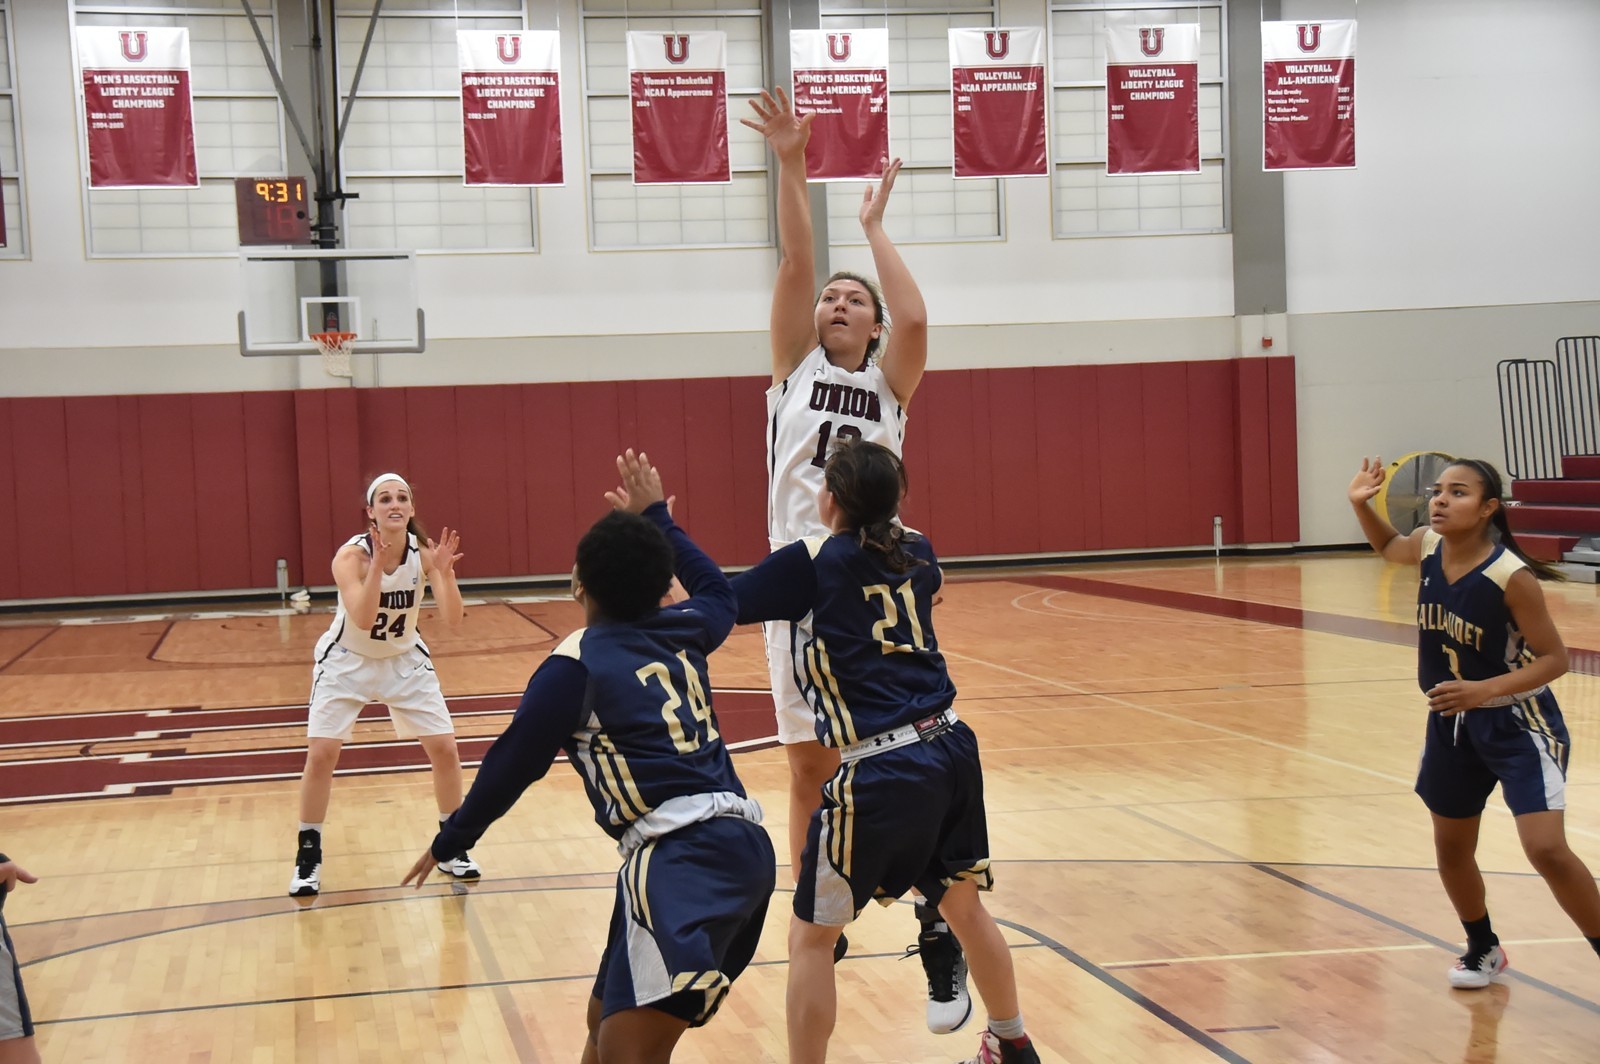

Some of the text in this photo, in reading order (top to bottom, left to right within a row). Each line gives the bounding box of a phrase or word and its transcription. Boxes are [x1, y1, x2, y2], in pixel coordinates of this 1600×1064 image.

[1139, 28, 1164, 57] U
[1296, 24, 1321, 53] U
[118, 31, 148, 62] U
[495, 33, 522, 64] U
[663, 34, 690, 64] U
[826, 32, 852, 63] U
[984, 30, 1010, 60] U
[1128, 69, 1176, 78] VOLLEYBALL
[1285, 65, 1332, 74] VOLLEYBALL
[93, 74, 180, 84] MEN'S BASKETBALL
[465, 76, 556, 86] WOMEN'S BASKETBALL
[643, 76, 714, 86] Women's Basketball
[797, 73, 884, 83] WOMEN'S BASKETBALL
[973, 71, 1022, 81] VOLLEYBALL
[1278, 75, 1340, 85] ALL-AMERICANS
[809, 85, 873, 95] ALL-AMERICANS
[961, 82, 1037, 93] NCAA APPEARANCES
[1121, 80, 1184, 90] LIBERTY LEAGUE
[100, 87, 175, 97] LIBERTY LEAGUE
[476, 88, 545, 98] LIBERTY LEAGUE
[644, 88, 714, 99] NCAA Appearances
[1130, 92, 1175, 100] CHAMPIONS
[112, 99, 165, 109] CHAMPIONS
[487, 100, 536, 109] CHAMPIONS
[256, 183, 302, 203] 9:31
[809, 380, 881, 423] UNION
[862, 578, 930, 656] 21
[370, 612, 407, 641] 24
[635, 649, 720, 755] 24
